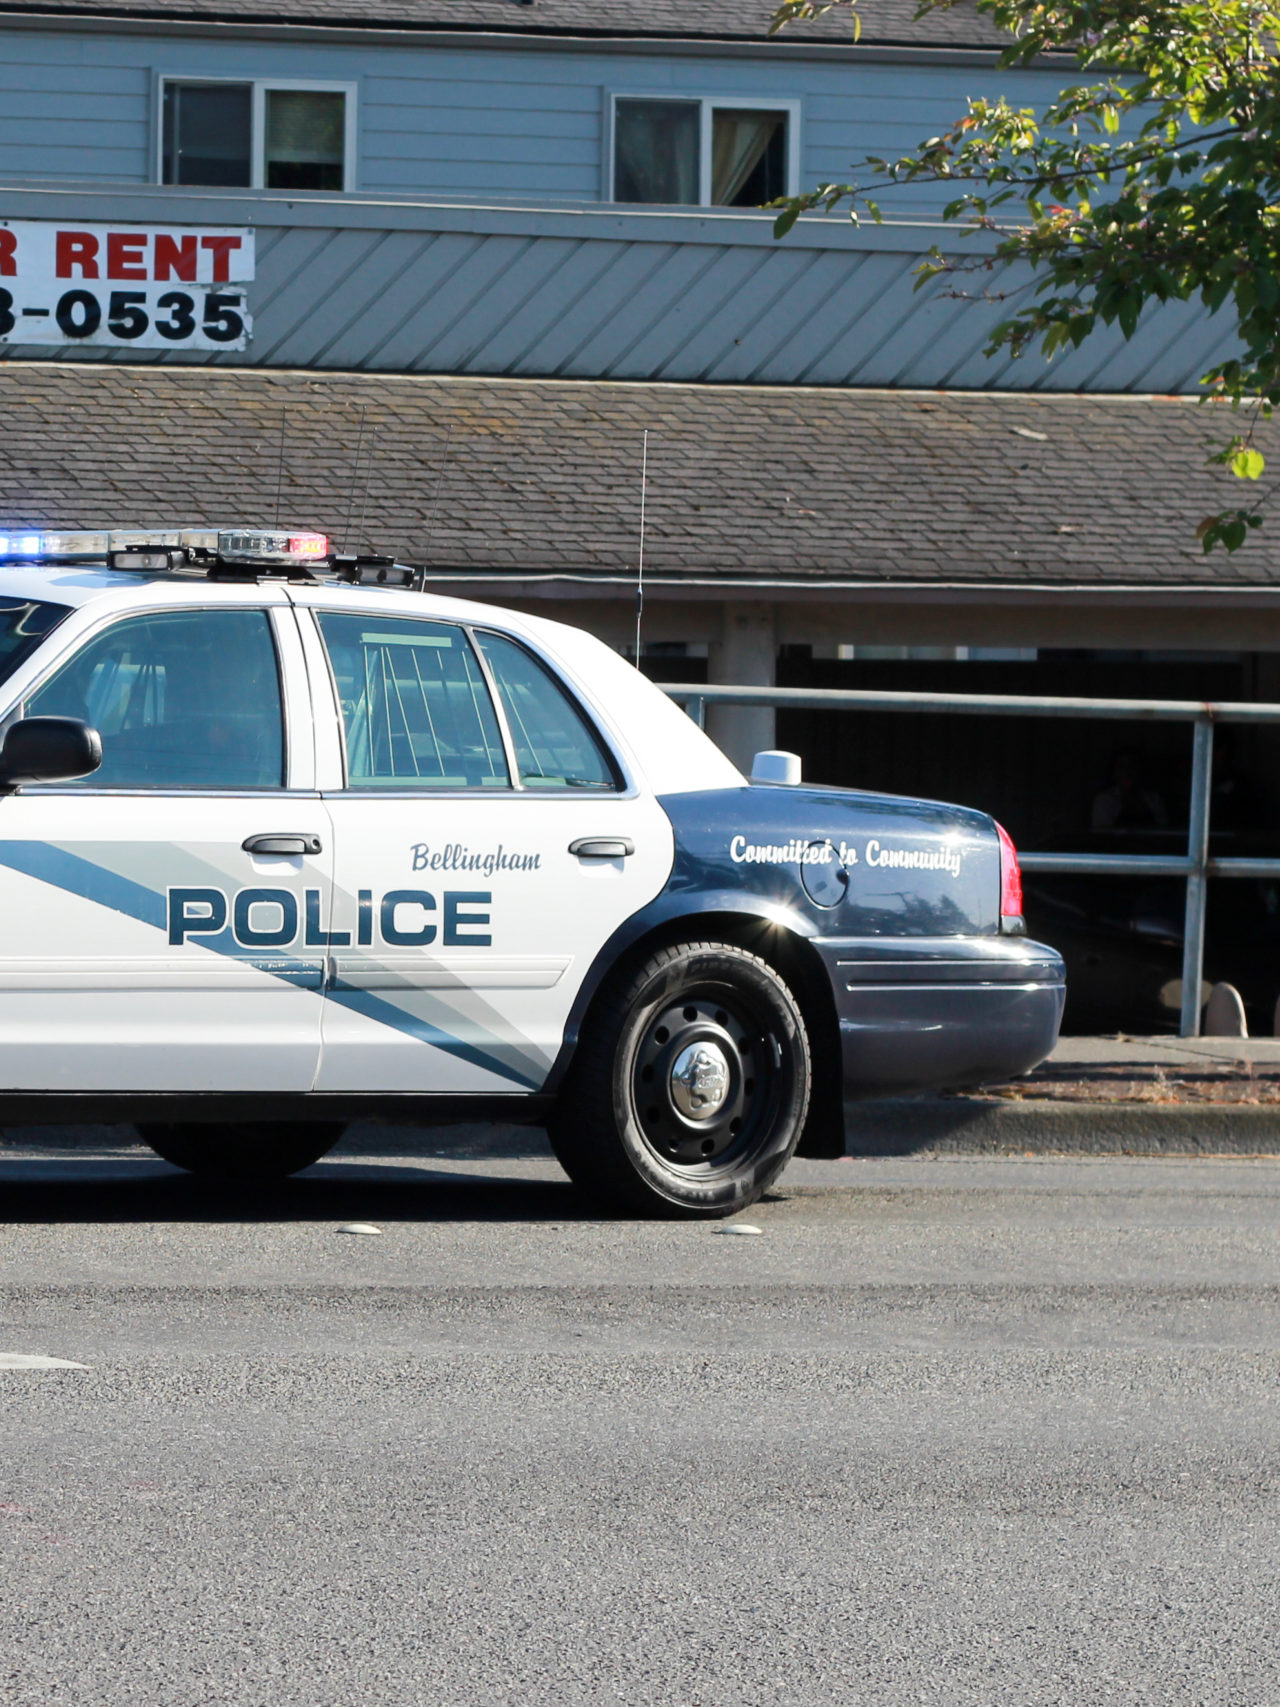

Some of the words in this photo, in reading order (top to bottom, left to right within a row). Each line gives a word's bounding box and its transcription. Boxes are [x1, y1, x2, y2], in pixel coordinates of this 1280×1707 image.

[55, 230, 243, 283] RENT
[410, 842, 541, 878] Bellingham
[730, 835, 832, 865] Committed
[838, 841, 858, 866] to
[866, 840, 961, 878] Community
[168, 887, 492, 948] POLICE
